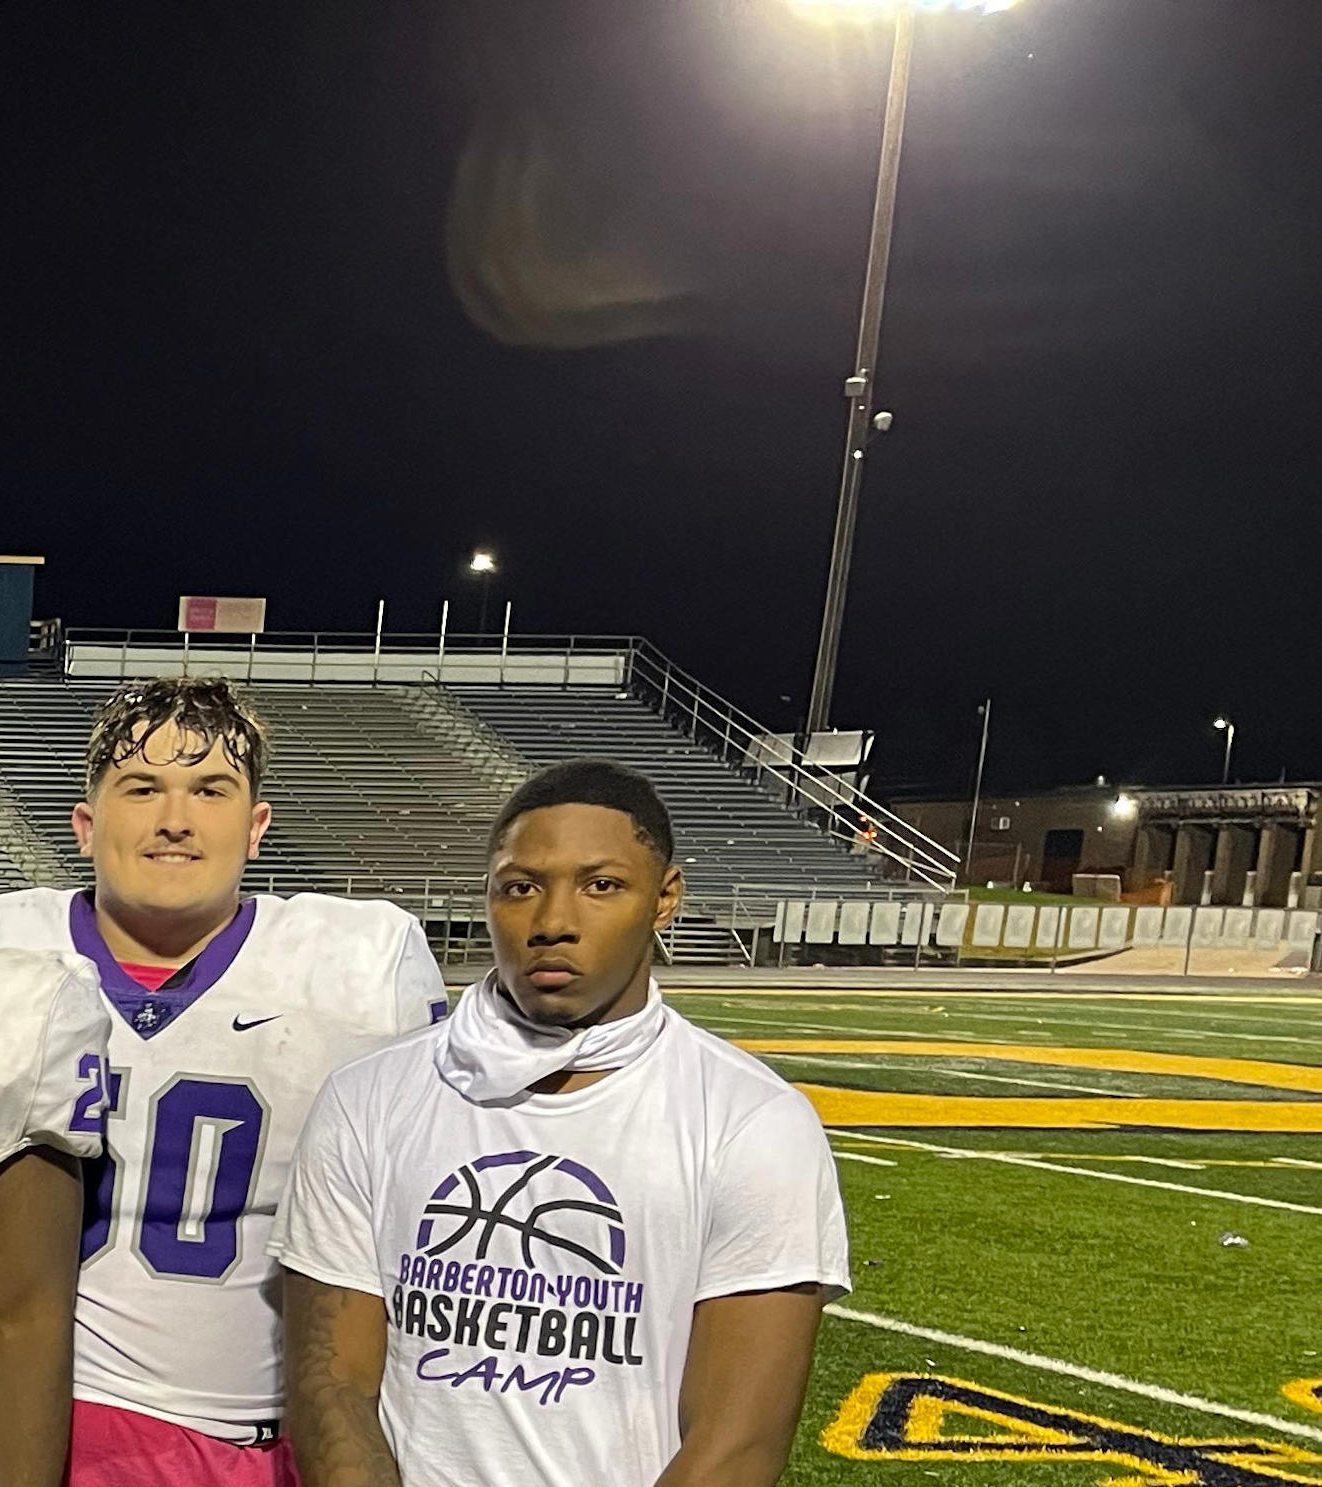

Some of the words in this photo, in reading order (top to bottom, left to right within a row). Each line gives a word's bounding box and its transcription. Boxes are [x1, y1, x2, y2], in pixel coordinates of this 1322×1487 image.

[399, 1253, 547, 1301] BARBERTON
[556, 1274, 645, 1314] YOUTH
[416, 1348, 596, 1406] CAMP
